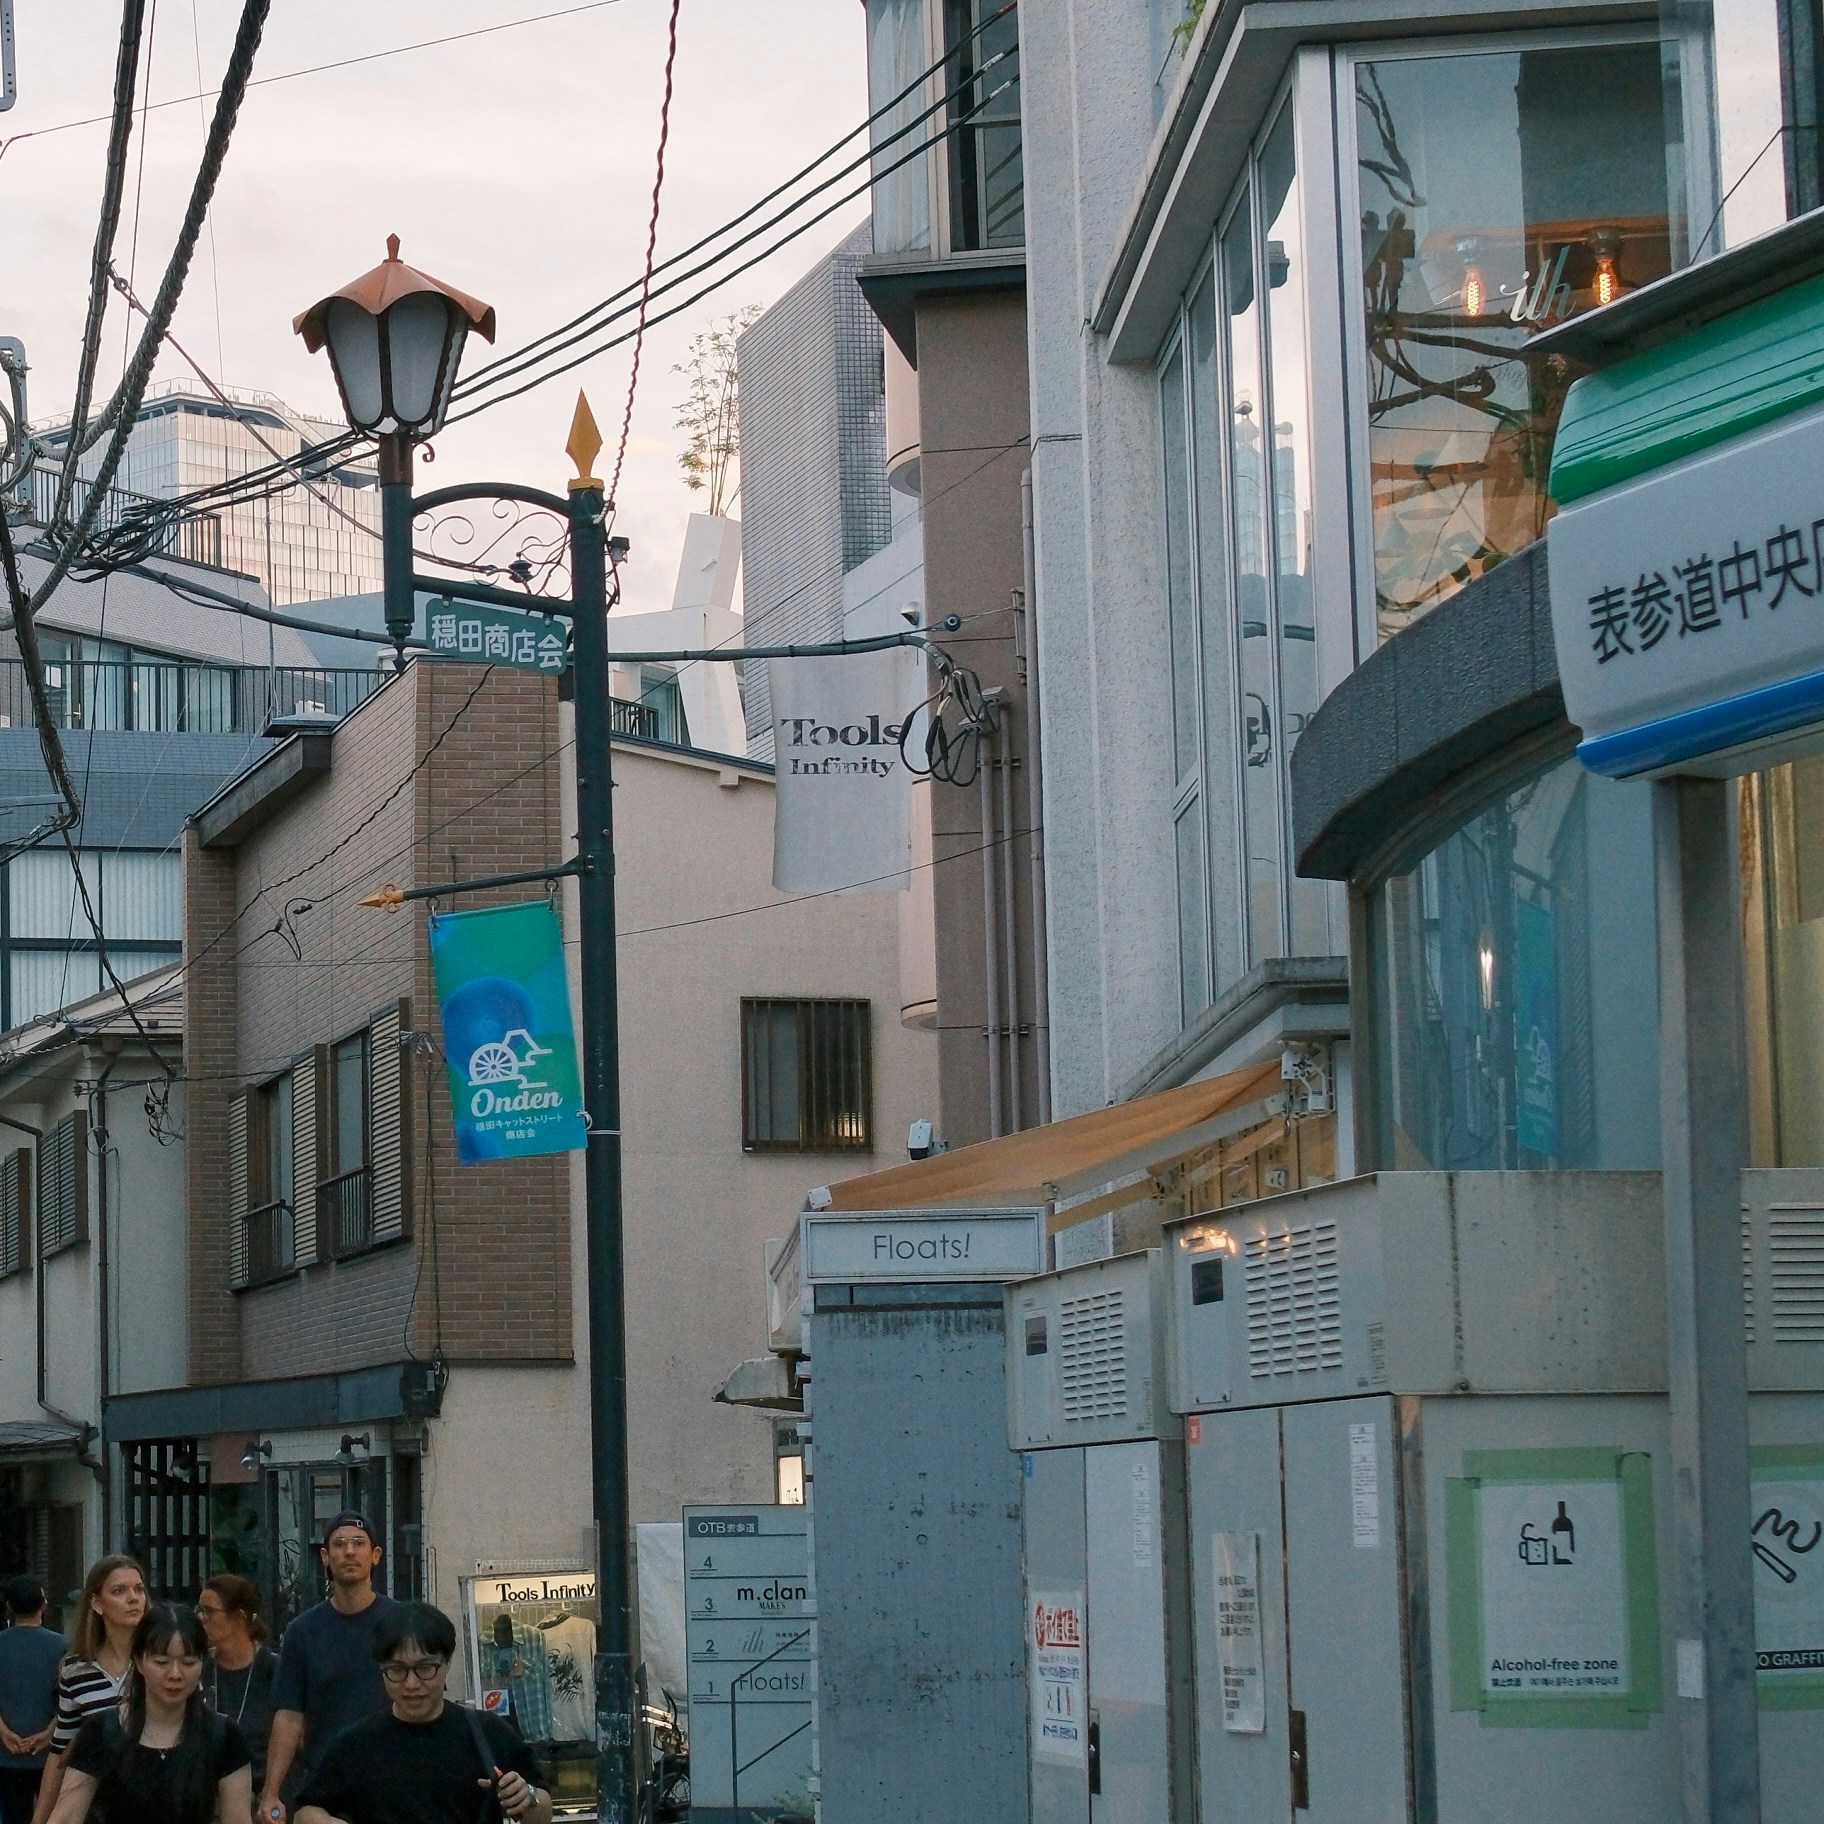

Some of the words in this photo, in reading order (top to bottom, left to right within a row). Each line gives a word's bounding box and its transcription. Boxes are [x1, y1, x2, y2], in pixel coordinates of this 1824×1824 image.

[431, 613, 564, 668] 穏田商店会
[780, 714, 902, 746] Tools
[789, 756, 895, 778] Infinity
[471, 1088, 563, 1117] Onden
[505, 1128, 536, 1140] 商店会
[874, 1233, 970, 1259] Floats!
[703, 1555, 713, 1569] 4
[496, 1582, 539, 1603] Tools
[540, 1579, 596, 1600] Infinity
[737, 1579, 806, 1601] m.clan
[704, 1597, 714, 1611] 3
[705, 1639, 715, 1653] 2
[1491, 1658, 1580, 1672] Alcohol-free
[1583, 1660, 1619, 1670] zone
[708, 1681, 714, 1694] 1
[739, 1672, 804, 1691] Floats!
